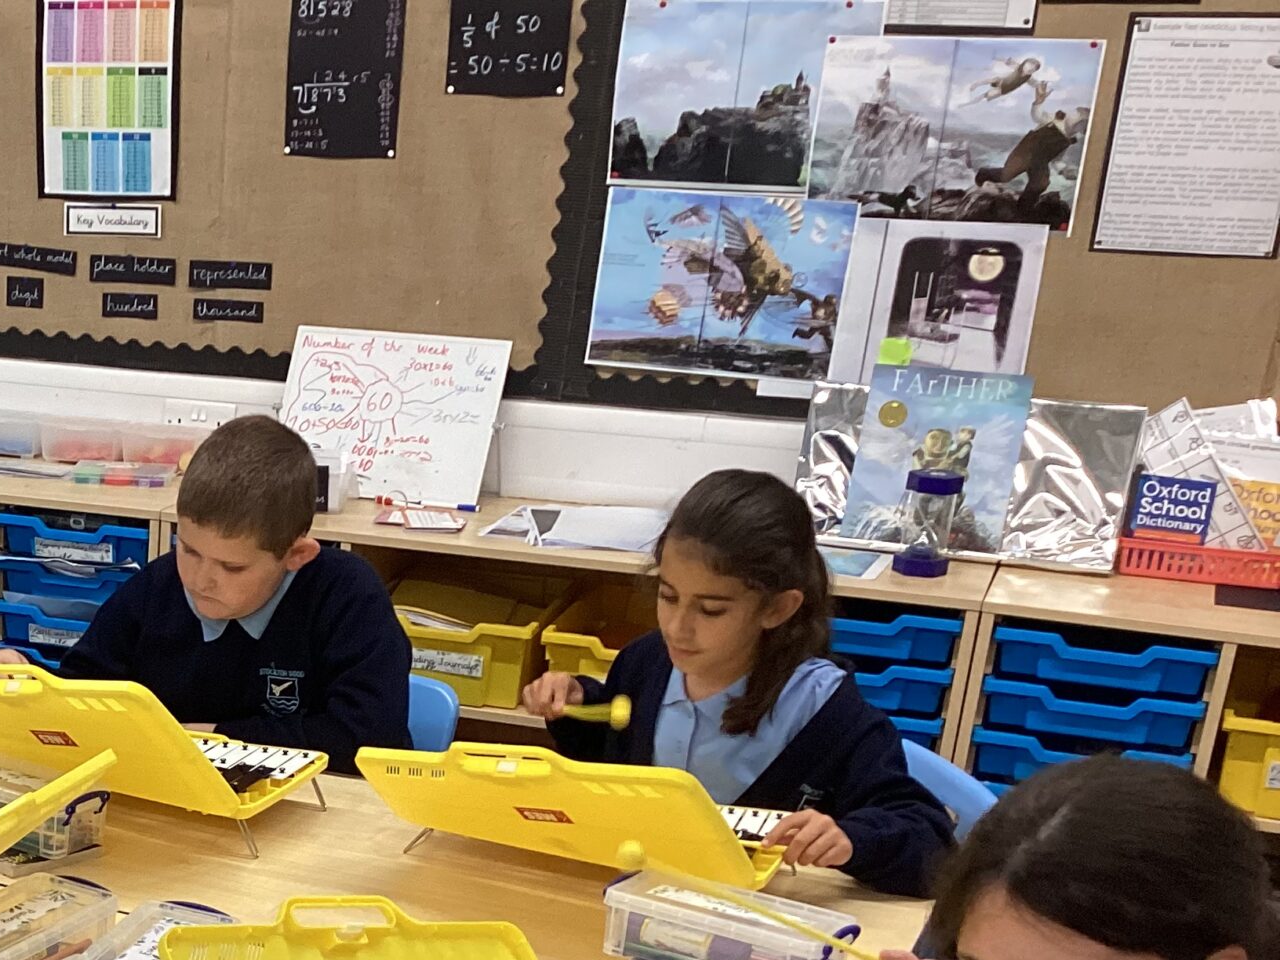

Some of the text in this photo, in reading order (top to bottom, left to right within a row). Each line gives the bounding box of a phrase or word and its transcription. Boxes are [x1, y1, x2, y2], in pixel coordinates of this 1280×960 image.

[516, 15, 541, 33] 50
[76, 214, 149, 229] Key Vocabulary
[94, 258, 172, 278] place holder
[193, 266, 267, 285] represented
[106, 299, 155, 313] hundred
[197, 303, 257, 318] thousand
[302, 335, 356, 350] Number
[361, 337, 375, 358] of
[367, 391, 393, 412] 60
[1142, 481, 1211, 503] Oxford
[1139, 497, 1207, 520] School
[1136, 514, 1205, 534] Dictionary
